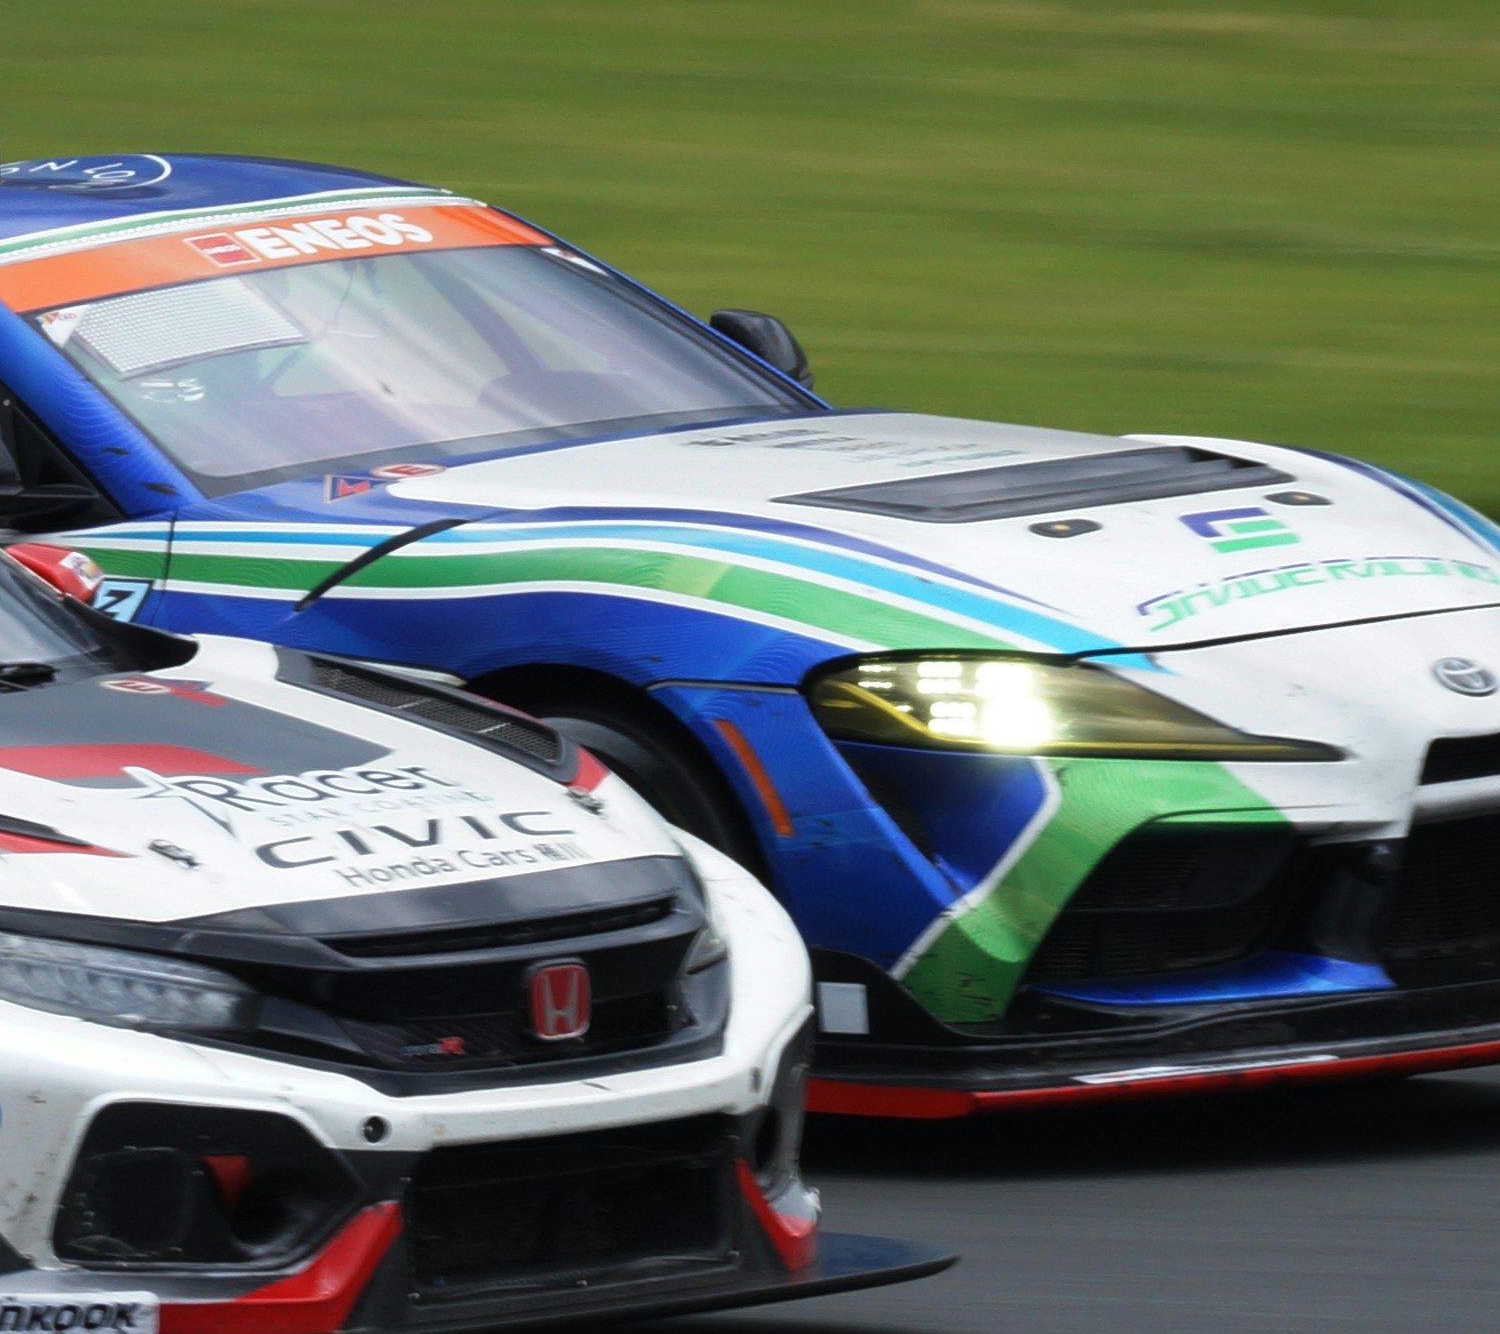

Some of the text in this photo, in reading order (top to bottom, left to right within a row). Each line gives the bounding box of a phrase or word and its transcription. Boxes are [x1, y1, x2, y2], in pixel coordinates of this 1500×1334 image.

[236, 213, 433, 260] ENEOS
[169, 766, 462, 813] Racer
[256, 811, 575, 869] CIVIC
[335, 853, 455, 888] Honda
[457, 844, 535, 869] Cars
